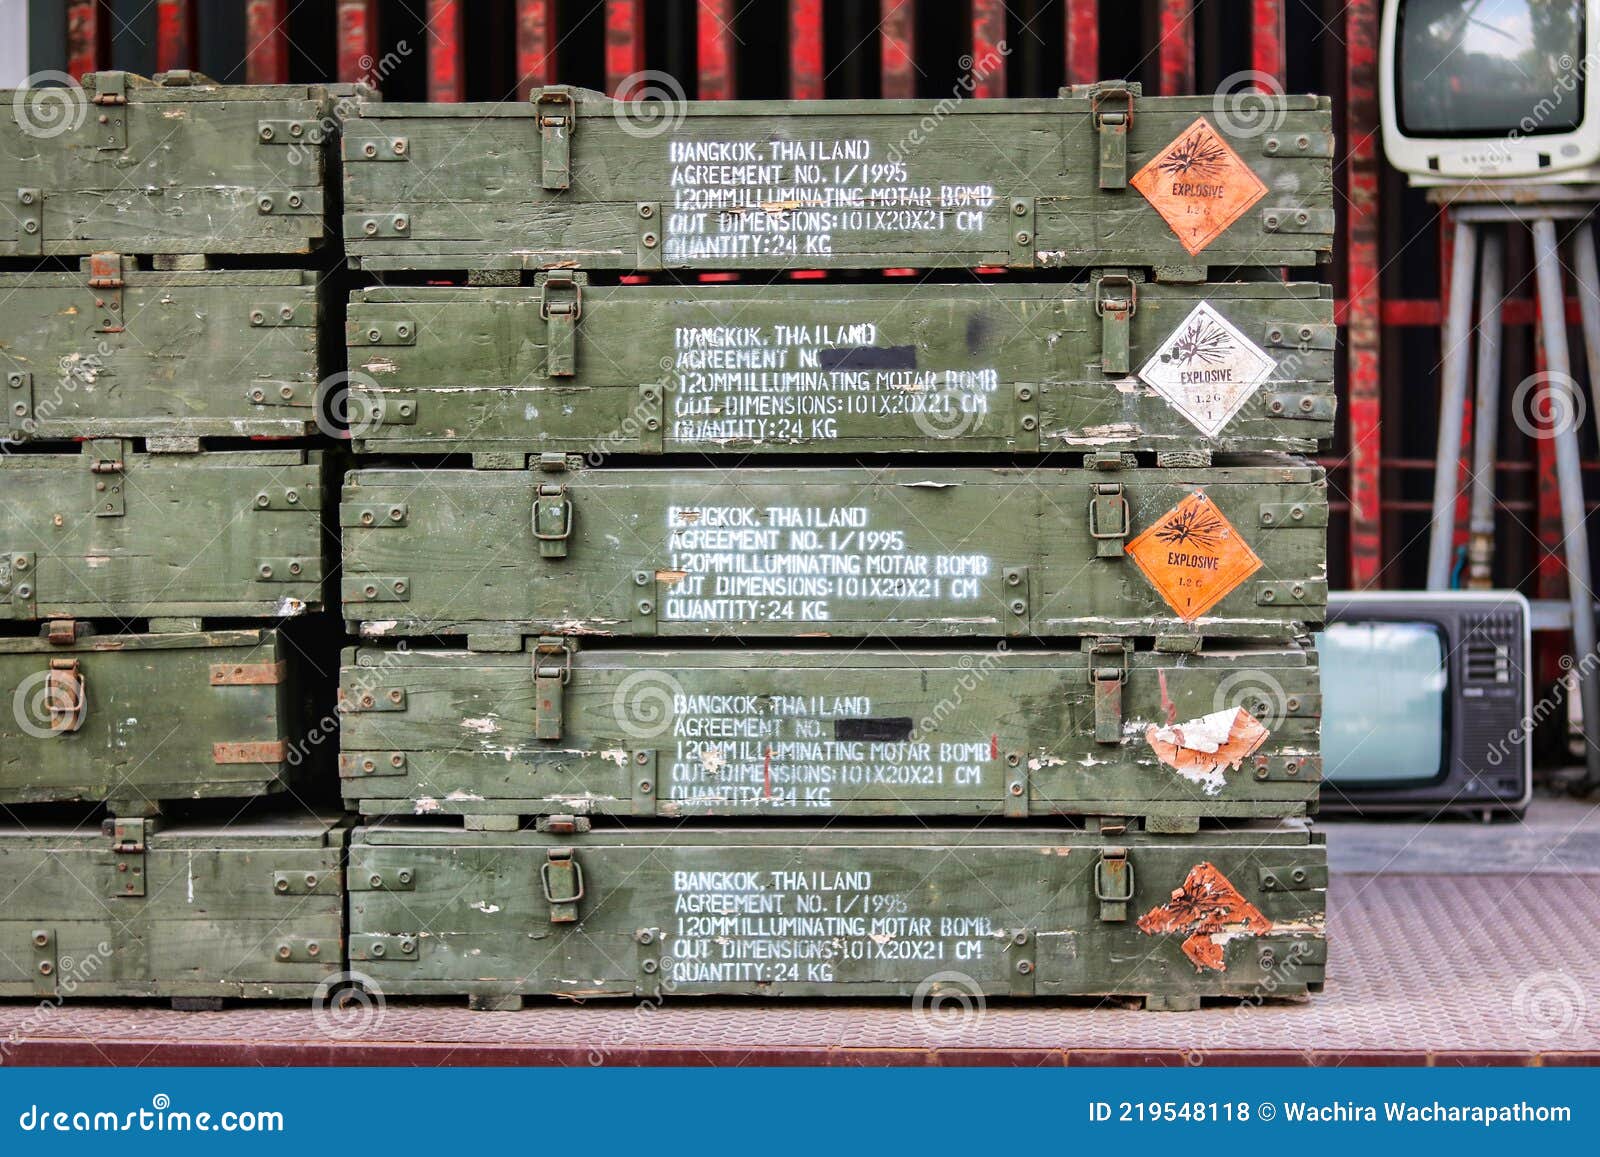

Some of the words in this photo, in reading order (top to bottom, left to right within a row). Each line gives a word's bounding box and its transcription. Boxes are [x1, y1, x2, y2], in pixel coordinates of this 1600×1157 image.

[770, 139, 870, 161] THAILAND
[670, 164, 782, 186] AGREEMENT
[871, 186, 932, 208] MOTAR
[940, 184, 994, 207] BOMB
[1172, 182, 1225, 199] EXPLOSIVE
[669, 212, 707, 234] OUT
[956, 210, 984, 232] CM
[805, 234, 833, 256] KG
[774, 324, 877, 346] THAILAND
[675, 349, 788, 370] AGREEMENT
[876, 369, 937, 392] MOTAR
[945, 368, 998, 392] BOMB
[1181, 368, 1232, 385] EXPLOSIVE
[674, 395, 714, 416] OUT
[961, 394, 988, 414] CM
[811, 418, 837, 439] KG
[766, 505, 867, 528] THAILAND
[668, 530, 780, 551] AGREEMENT
[865, 554, 927, 575] MOTAR
[935, 554, 989, 576] BOMB
[1168, 551, 1220, 571] EXPLOSIVE
[951, 577, 978, 599] CM
[801, 600, 829, 620] KG
[770, 695, 872, 716] THAILAND
[673, 717, 784, 738] AGREEMENT
[870, 741, 931, 762] MOTAR
[940, 741, 992, 763] BOMB
[672, 763, 707, 784] OUT
[955, 765, 981, 785] CM
[805, 786, 832, 808] KG
[770, 870, 872, 891] THAILAND
[674, 893, 785, 914] AGREEMENT
[871, 916, 931, 937] MOTAR
[940, 916, 992, 938] BOMB
[673, 940, 710, 960] OUT
[955, 940, 982, 960] CM
[807, 963, 834, 984] KG
